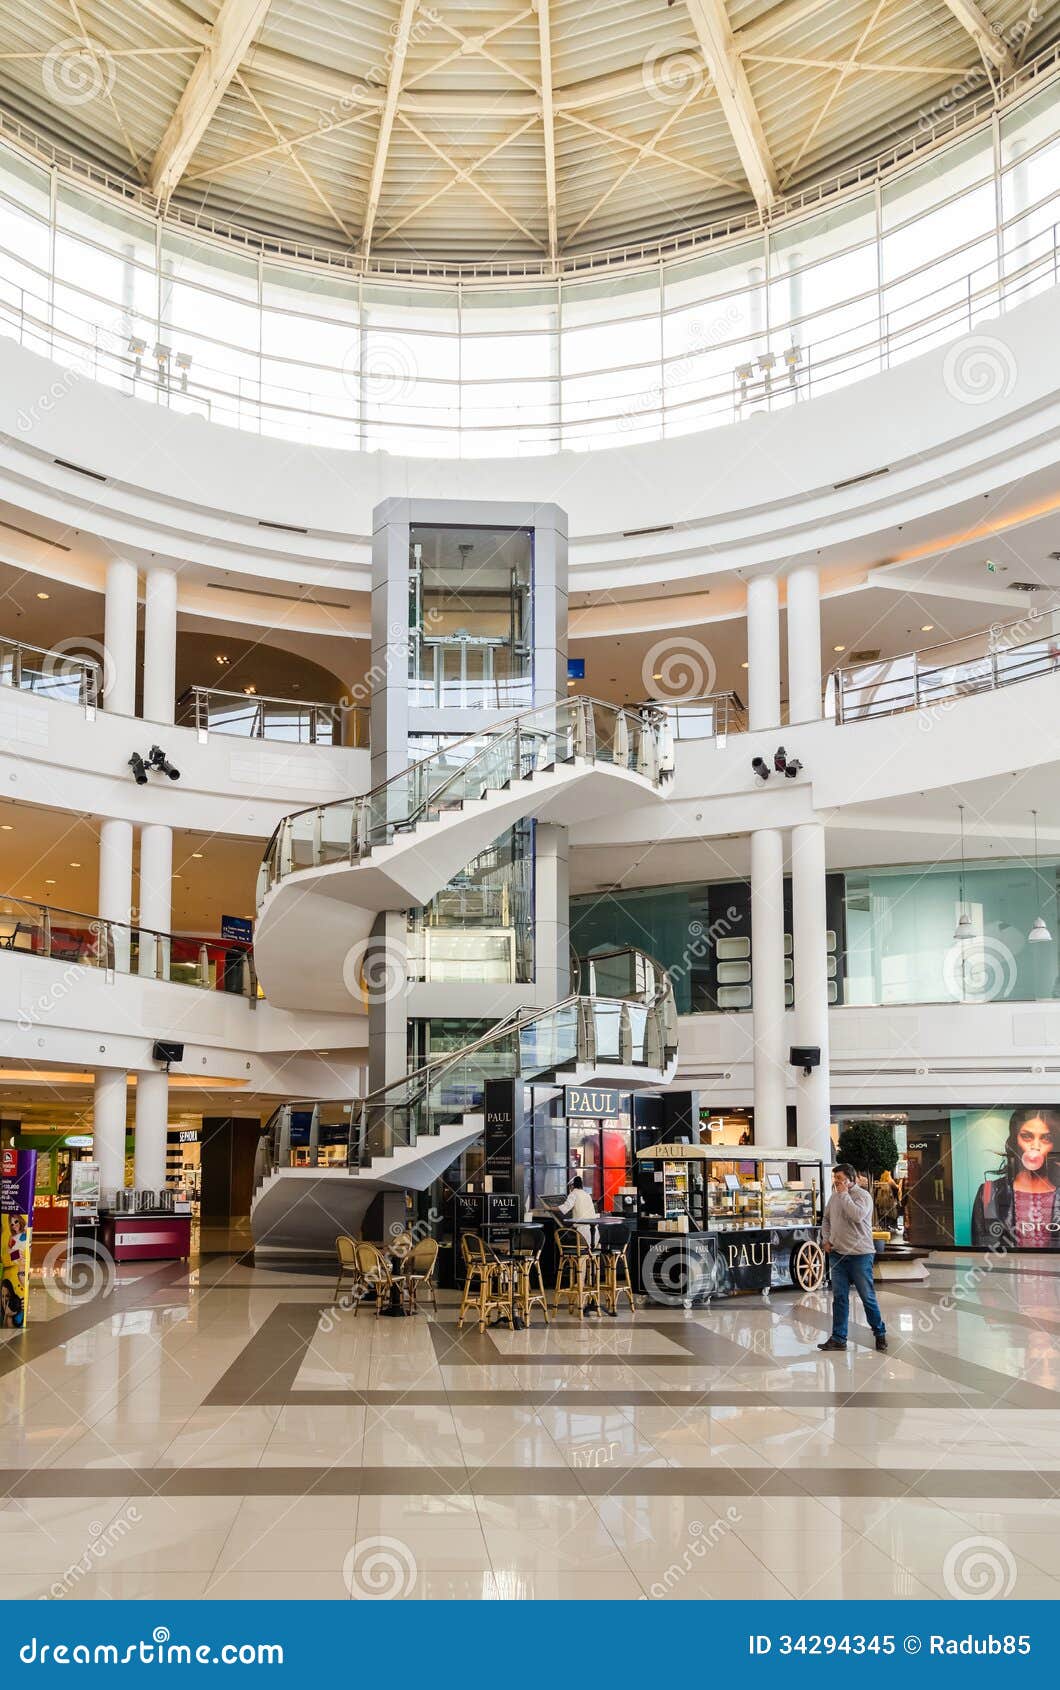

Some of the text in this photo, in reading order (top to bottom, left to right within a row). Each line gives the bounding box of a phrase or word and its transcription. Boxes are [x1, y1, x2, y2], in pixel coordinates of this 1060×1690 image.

[569, 1091, 616, 1113] PAUL
[487, 1112, 511, 1122] PAUL
[655, 1146, 687, 1157] PAUL
[459, 1198, 479, 1207] PAUL
[492, 1198, 515, 1207] PAUL
[728, 1242, 777, 1269] PAUL
